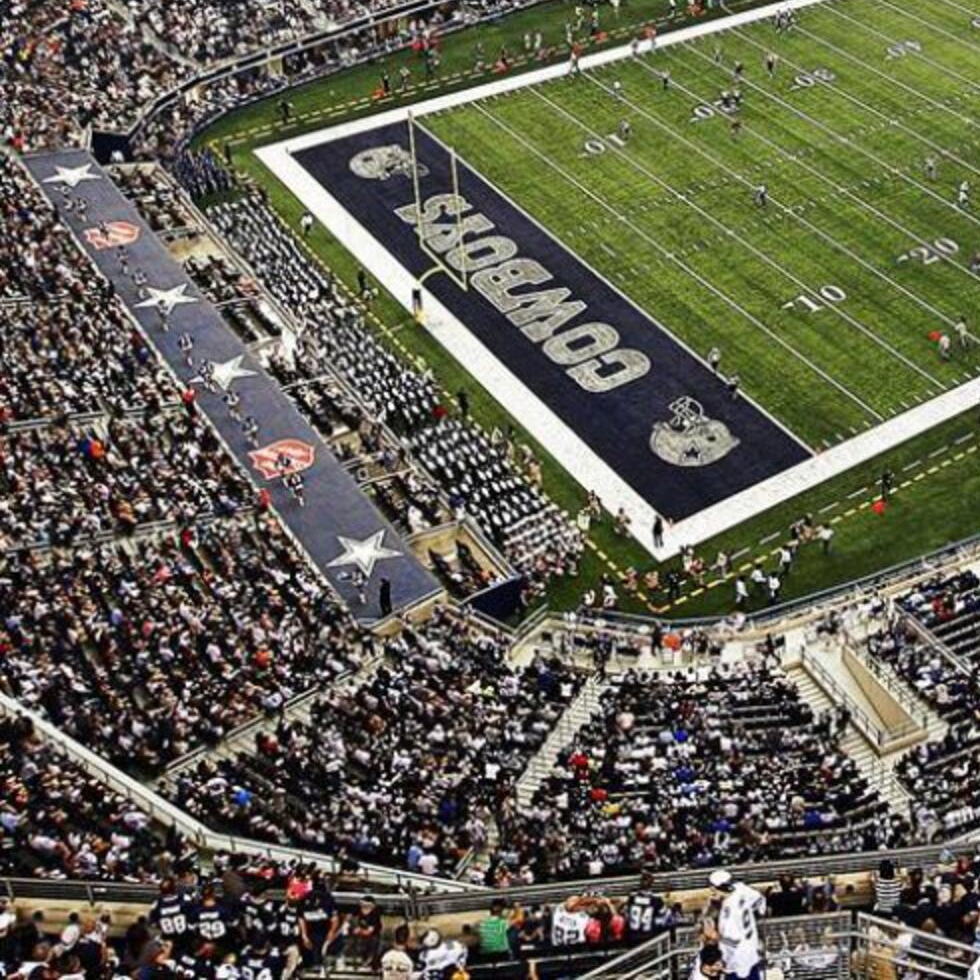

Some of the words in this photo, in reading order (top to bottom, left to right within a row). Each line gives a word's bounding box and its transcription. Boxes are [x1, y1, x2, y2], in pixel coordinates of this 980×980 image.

[585, 133, 626, 155] 10
[909, 237, 960, 265] 20
[393, 191, 652, 393] COWBOYS
[796, 285, 847, 312] 10
[159, 913, 187, 935] 88
[629, 905, 654, 932] 94
